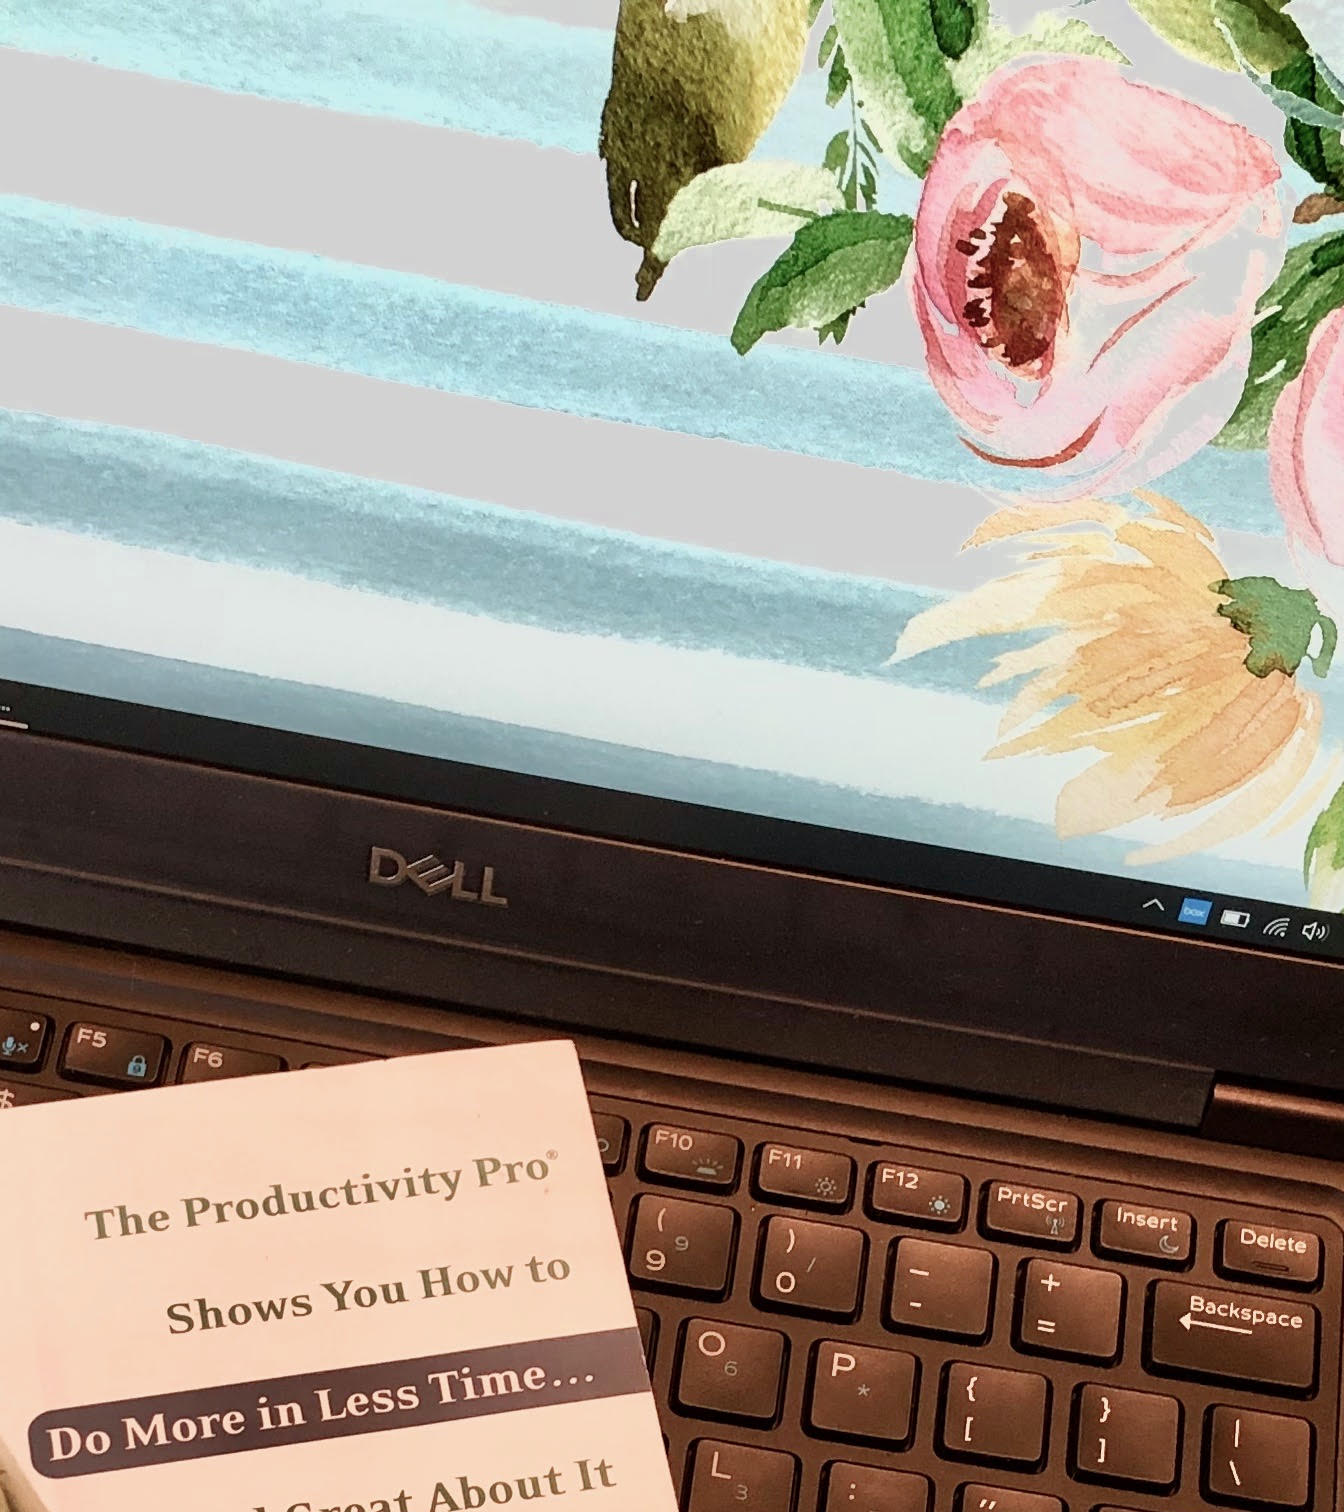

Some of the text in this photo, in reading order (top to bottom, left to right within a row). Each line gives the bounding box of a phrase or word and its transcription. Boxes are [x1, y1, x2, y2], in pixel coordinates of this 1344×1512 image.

[369, 846, 509, 908] DELL
[76, 1028, 108, 1049] F5
[193, 1048, 224, 1069] F6
[655, 1129, 693, 1152] F10
[768, 1149, 803, 1170] F11
[881, 1168, 920, 1190] F12
[85, 1205, 171, 1241] The
[180, 1167, 462, 1229] Productivity
[997, 1187, 1068, 1213] PrtScr
[1116, 1206, 1179, 1234] Insert
[674, 1235, 690, 1252] 9
[1240, 1228, 1308, 1255] Delete
[645, 1249, 667, 1271] 9
[166, 1254, 571, 1335] Shows You How to
[1040, 1273, 1061, 1292] +
[1189, 1296, 1304, 1330] Backspace
[1037, 1319, 1056, 1334] =
[698, 1330, 726, 1357] O
[831, 1352, 856, 1377] P
[966, 1376, 978, 1402] {
[45, 1424, 111, 1462] Do
[120, 1409, 247, 1451] More
[257, 1396, 307, 1430] in
[313, 1381, 420, 1422] Less
[1099, 1396, 1111, 1423] }
[964, 1416, 974, 1442] [
[1097, 1438, 1106, 1463] ]
[575, 1457, 618, 1491] It
[711, 1451, 732, 1480] L
